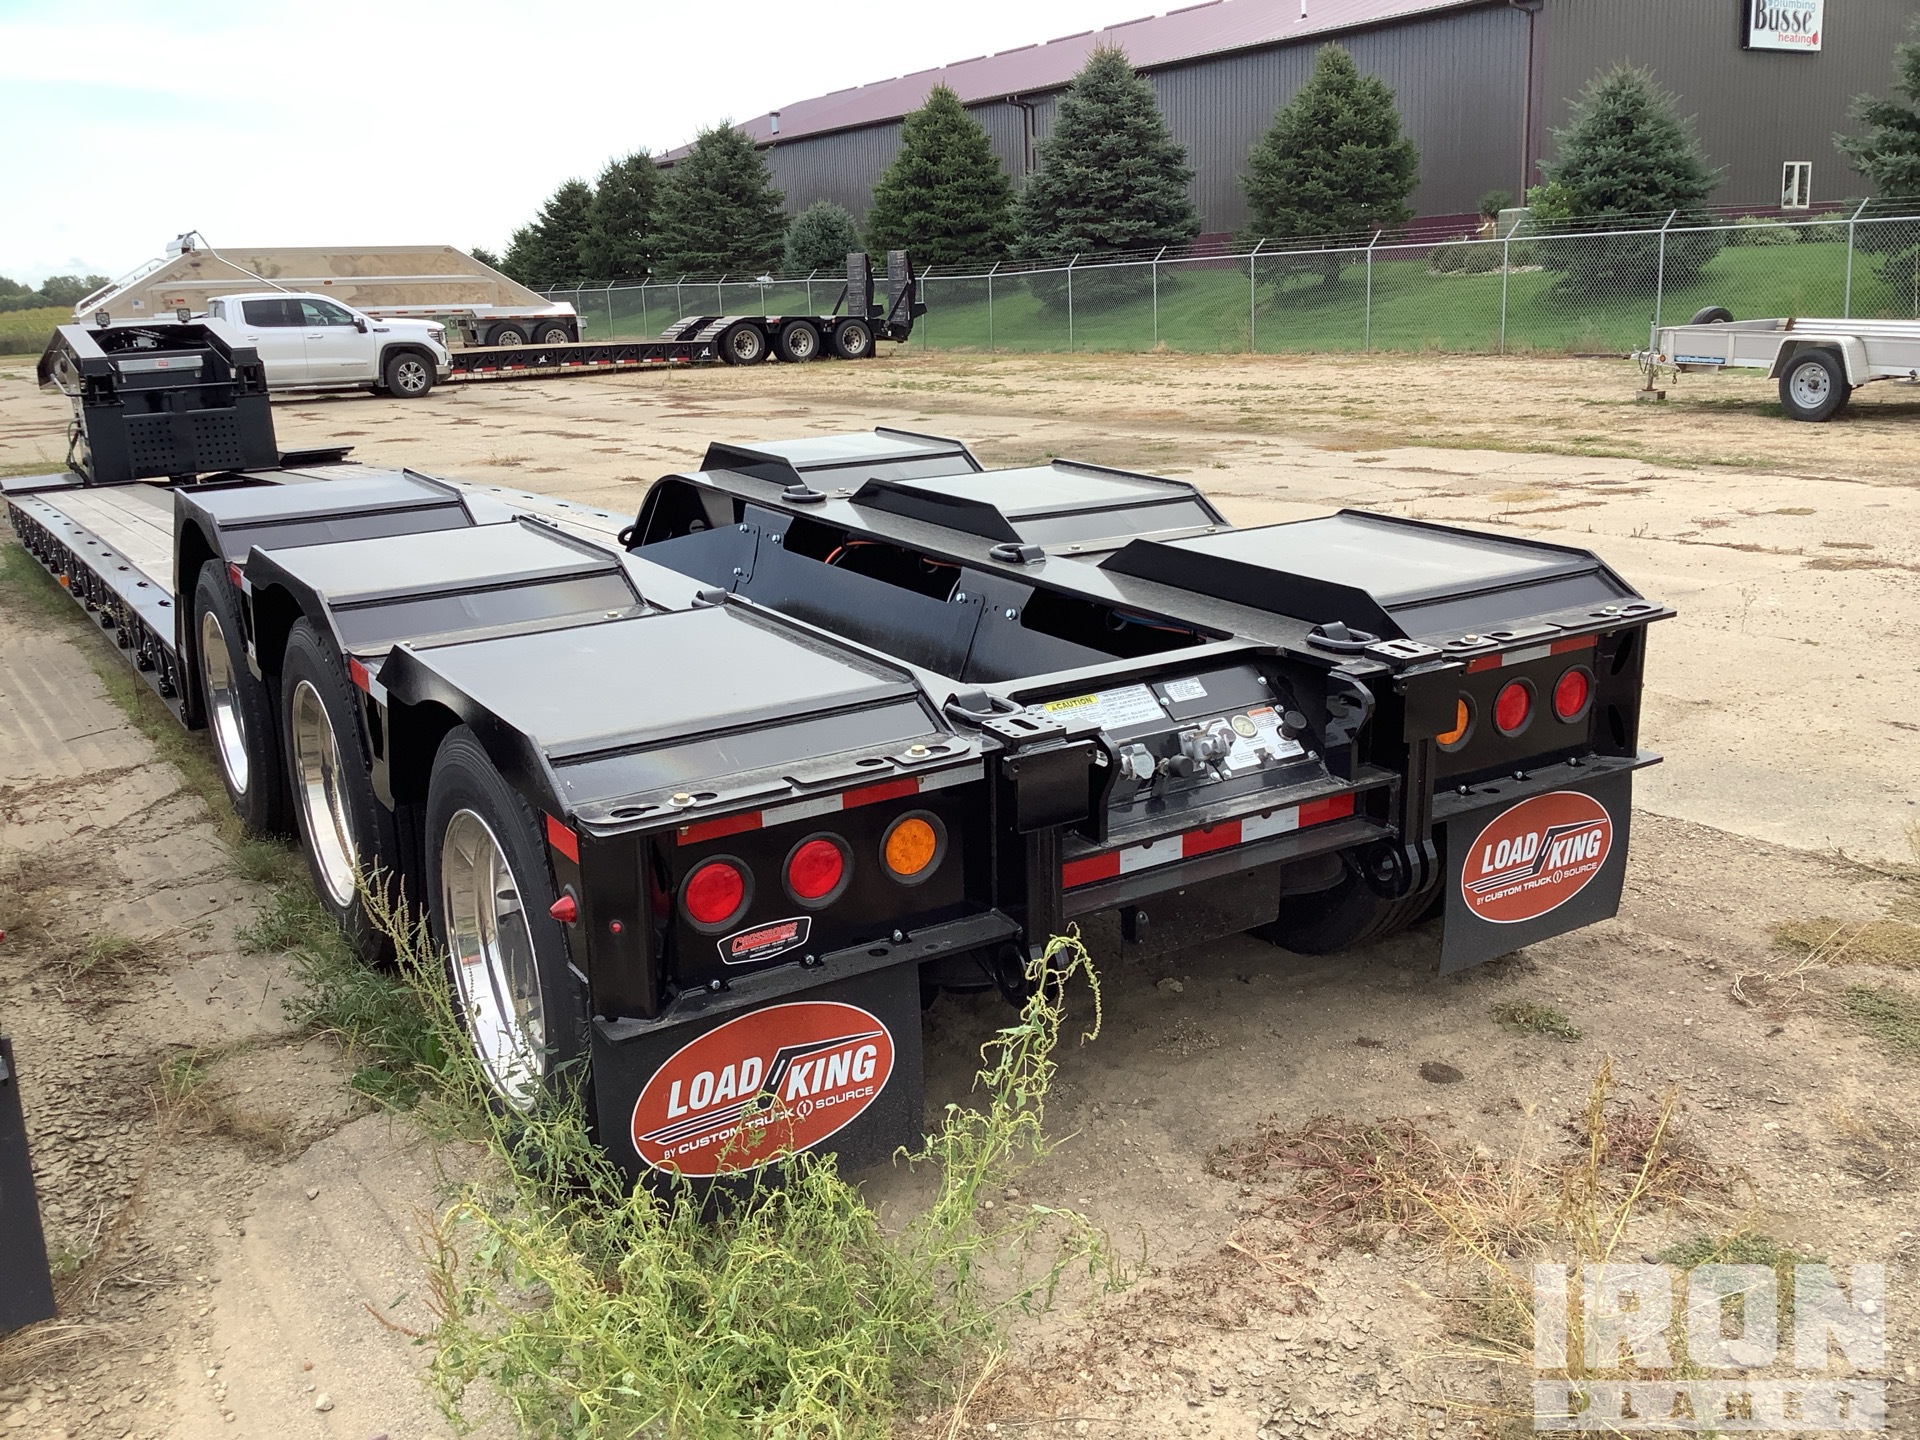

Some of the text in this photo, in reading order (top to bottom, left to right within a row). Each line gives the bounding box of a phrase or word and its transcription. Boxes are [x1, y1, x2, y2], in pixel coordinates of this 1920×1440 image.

[1754, 0, 1812, 33] Busse
[1774, 0, 1816, 12] plumbing
[1778, 31, 1811, 46] heating
[1057, 697, 1093, 711] CAUTION
[1481, 829, 1603, 874] LOAD KING
[1476, 898, 1484, 906] BY
[1485, 885, 1522, 902] CUSTOM
[1523, 877, 1552, 890] TRUCK
[1563, 862, 1597, 878] SOURCE
[667, 1044, 877, 1120] LOAD KING
[664, 1147, 676, 1160] BY
[678, 1126, 742, 1155] CUSTOM
[745, 1108, 795, 1129] TRUCK
[815, 1085, 874, 1110] SOURCE
